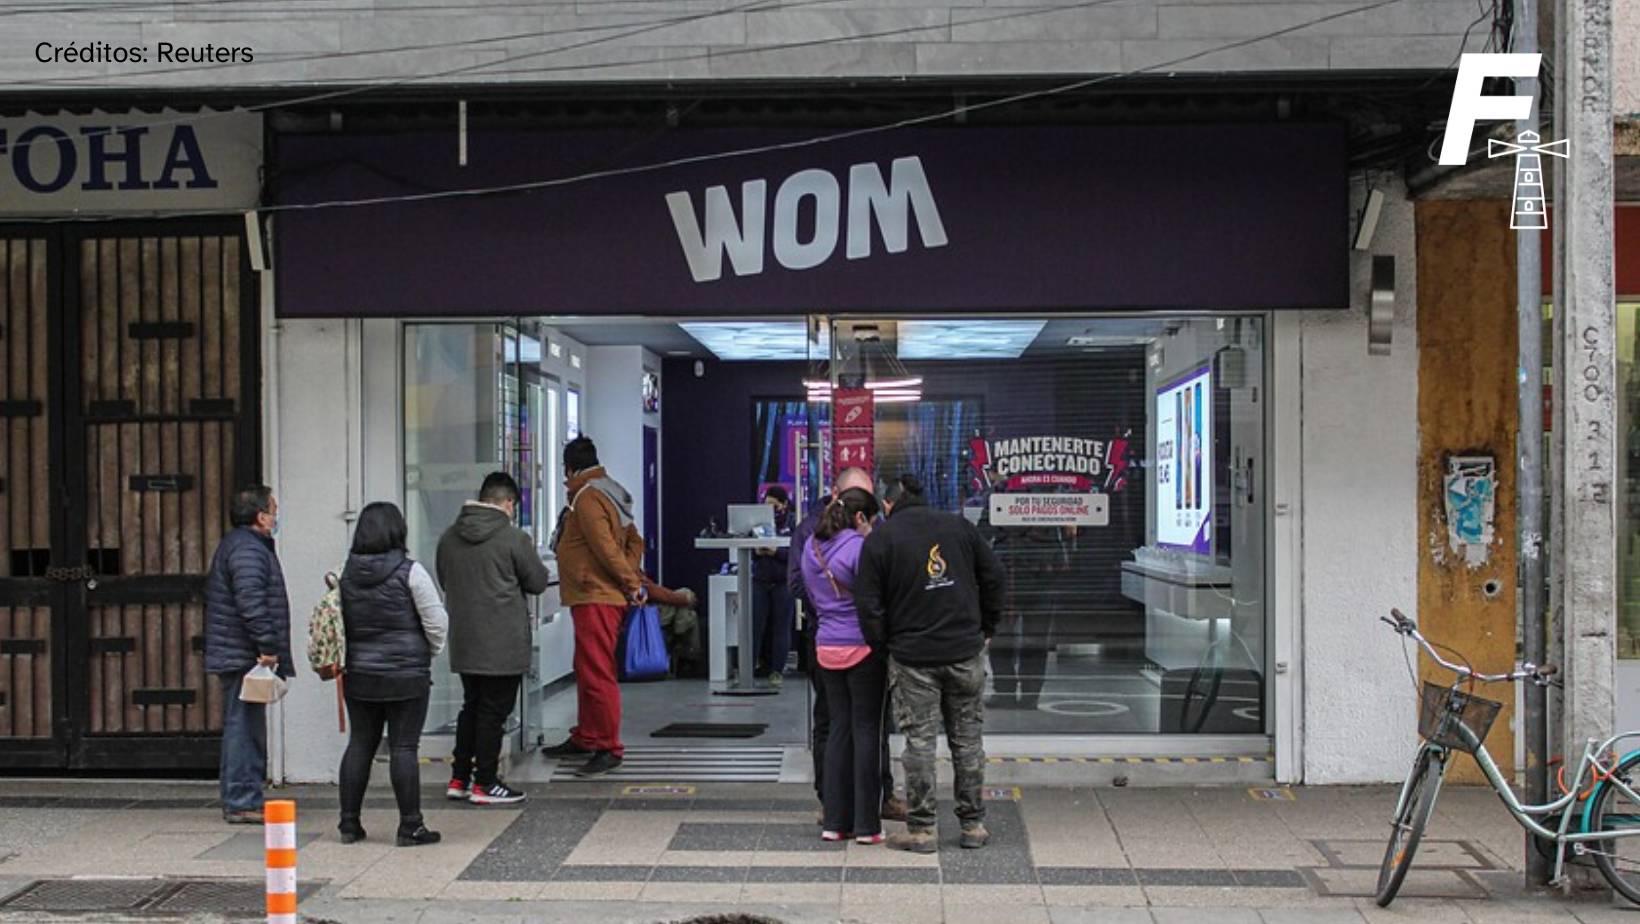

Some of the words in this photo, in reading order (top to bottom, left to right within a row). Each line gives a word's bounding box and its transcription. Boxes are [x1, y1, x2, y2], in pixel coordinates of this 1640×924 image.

[0, 125, 218, 193] OHA
[665, 156, 949, 282] WOM
[994, 437, 1104, 457] MANTENERTE
[998, 454, 1101, 475] CONECTADO
[1008, 506, 1030, 516] SOLO
[1031, 506, 1059, 516] PAGOS
[1060, 506, 1089, 516] ONLINE
[1015, 497, 1030, 506] POR
[1032, 497, 1042, 506] TU
[1043, 497, 1083, 506] SEGURIDAD
